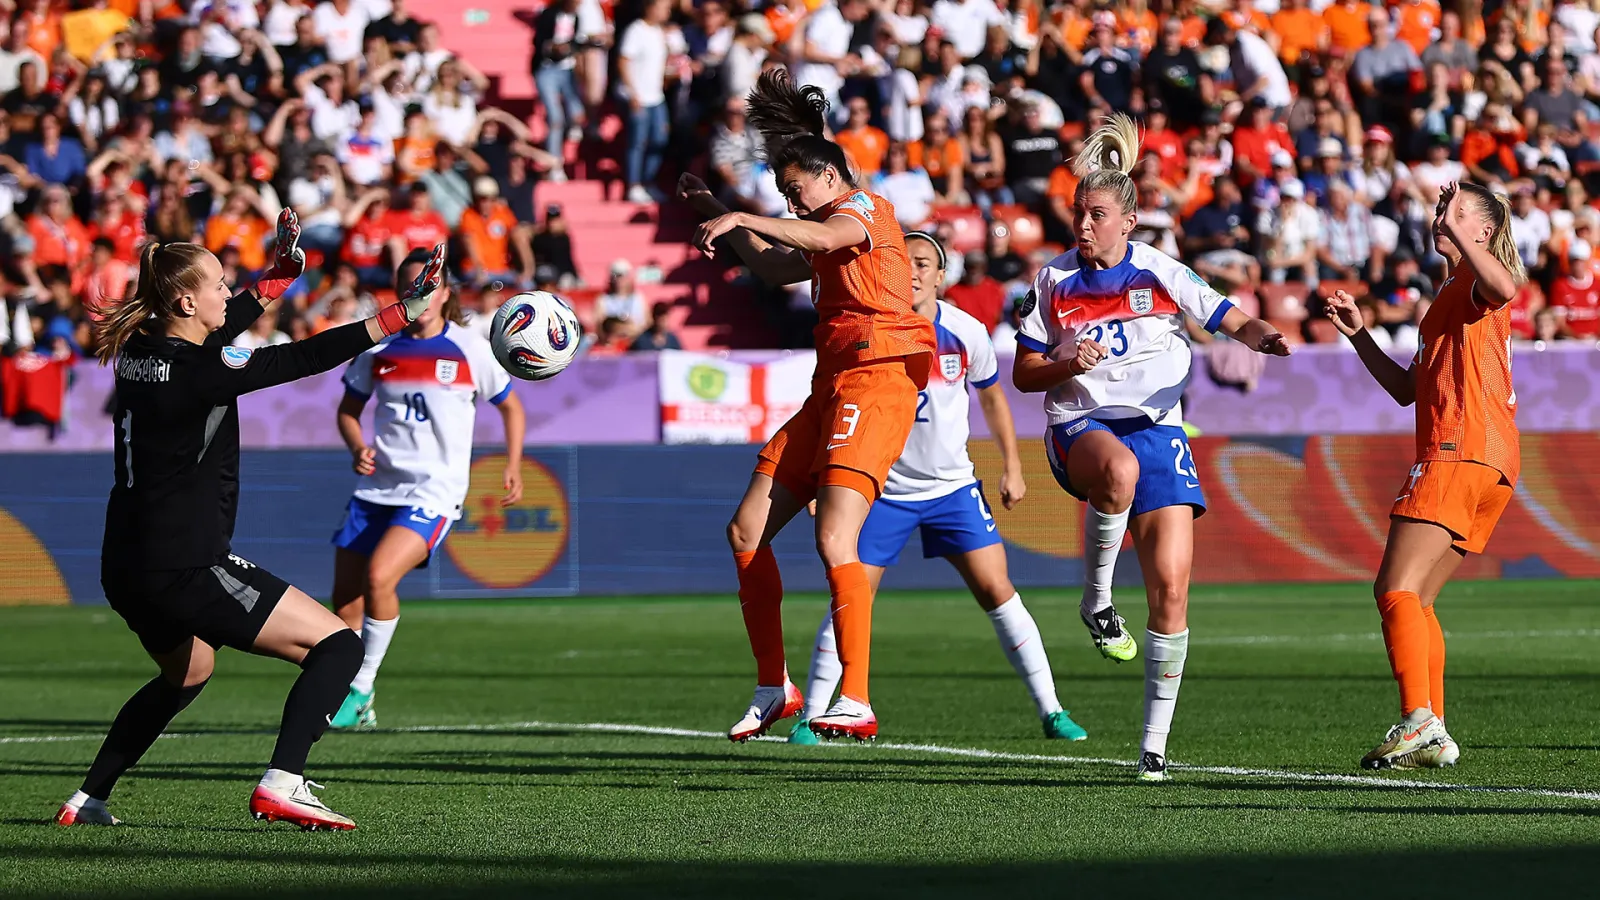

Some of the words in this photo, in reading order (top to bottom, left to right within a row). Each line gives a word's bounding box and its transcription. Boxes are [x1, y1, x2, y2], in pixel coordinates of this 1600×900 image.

[404, 391, 428, 422] 10
[832, 403, 861, 440] 3
[1408, 462, 1424, 490] 4
